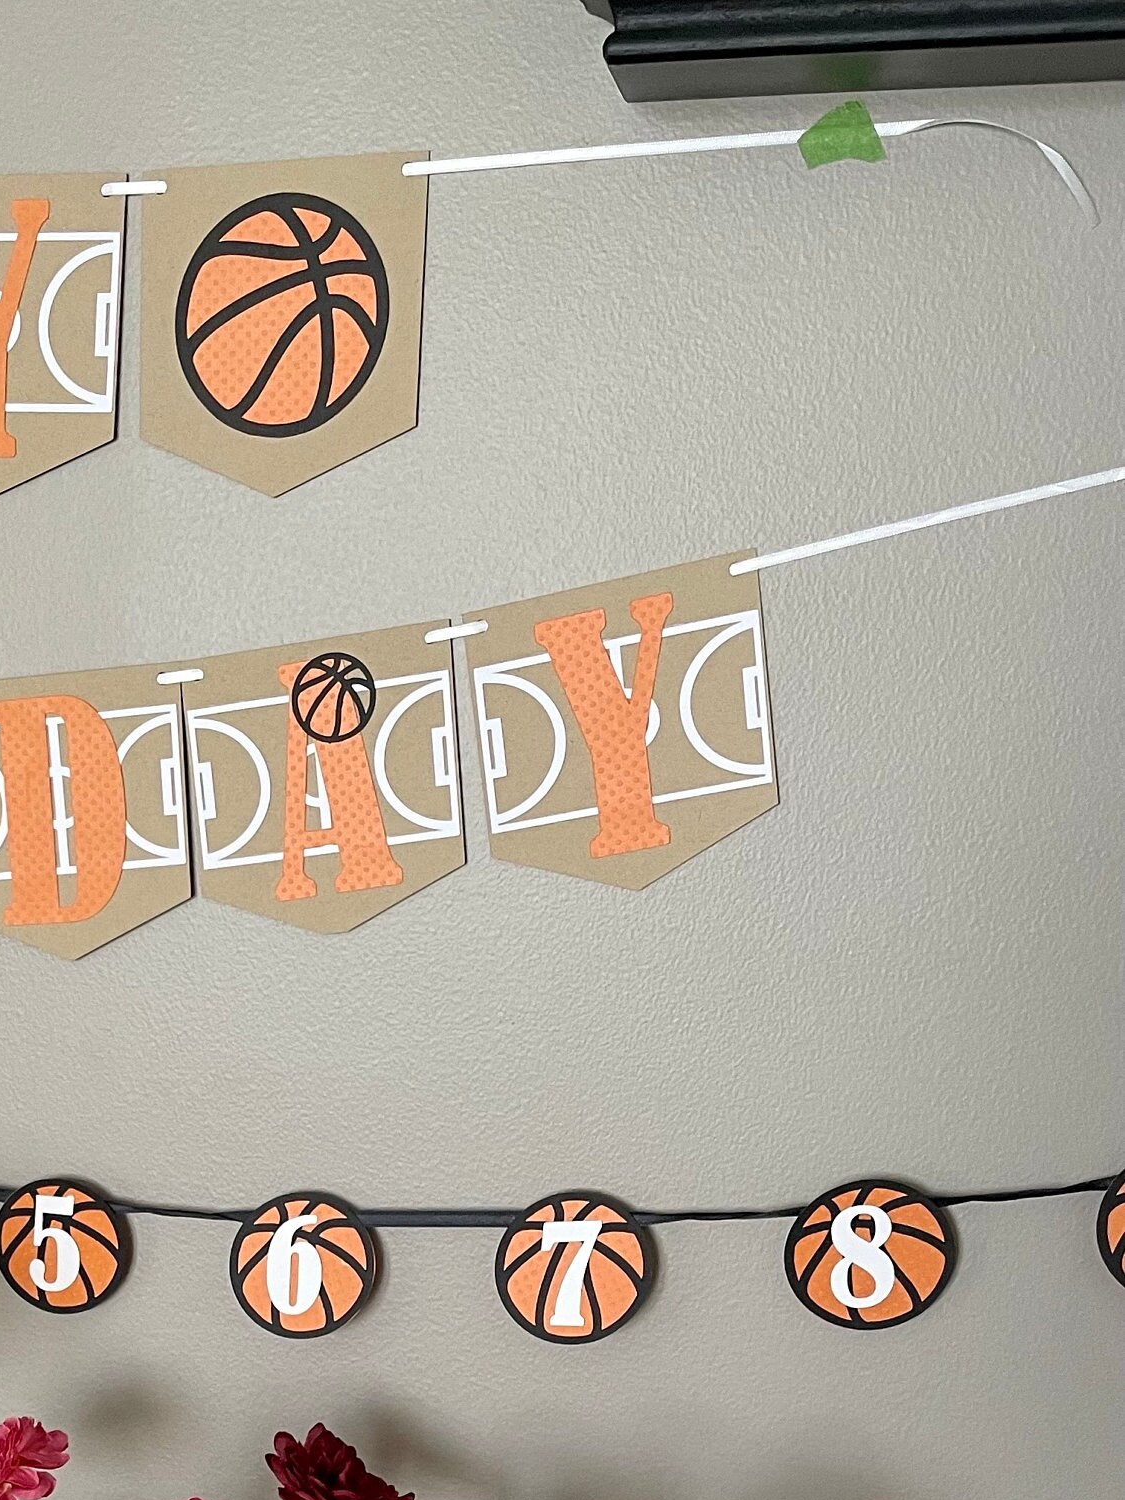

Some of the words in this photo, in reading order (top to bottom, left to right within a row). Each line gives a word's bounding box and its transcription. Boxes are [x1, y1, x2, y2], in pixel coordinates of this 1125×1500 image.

[28, 1195, 81, 1292] 5
[266, 1214, 324, 1315] 6
[541, 1220, 603, 1326] 7
[830, 1204, 896, 1309] 8
